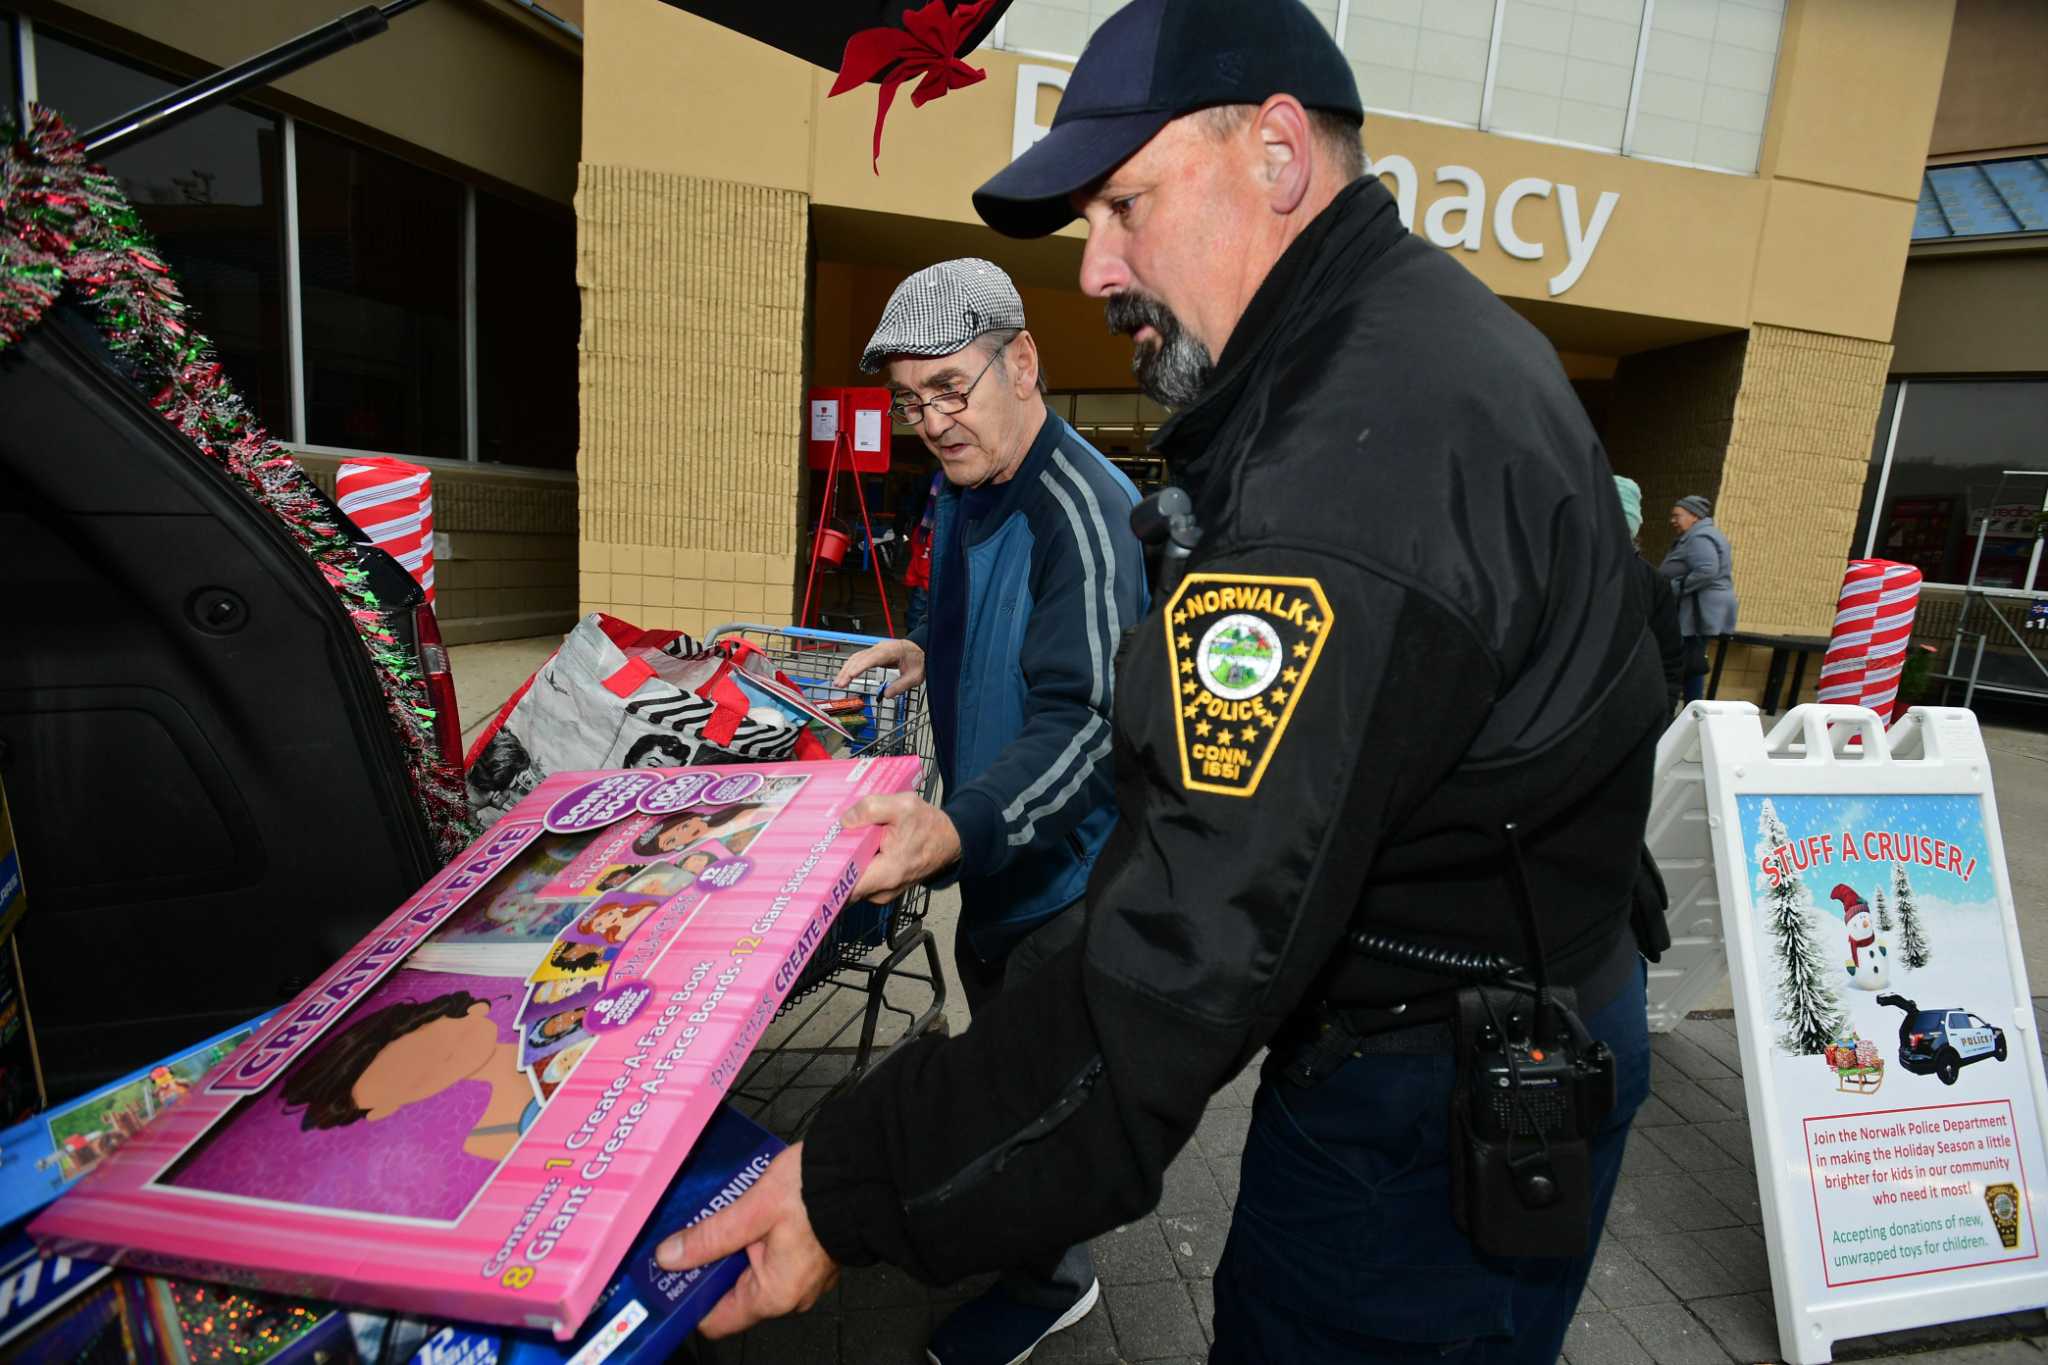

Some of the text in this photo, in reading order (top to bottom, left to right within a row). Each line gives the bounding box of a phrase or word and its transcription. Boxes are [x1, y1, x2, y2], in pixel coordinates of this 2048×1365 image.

[1186, 586, 1311, 626] NORWALK
[1194, 690, 1267, 721] POLICE
[1192, 744, 1251, 766] CONN.
[556, 776, 625, 826] BONUS
[649, 776, 694, 809] 1000
[1762, 832, 1976, 886] STUFF A CRUISER!
[775, 919, 821, 993] CREATE
[833, 861, 858, 905] FACE
[237, 935, 408, 1079] CREATE
[410, 902, 449, 923] A
[445, 826, 531, 890] FACE
[594, 998, 613, 1012] 8
[501, 1265, 536, 1289] 8
[525, 1184, 592, 1262] Giant
[582, 1028, 693, 1181] Create-A-Face
[690, 967, 741, 1023] Boards
[730, 936, 762, 957] 12
[752, 896, 791, 934] Giant
[781, 853, 820, 894] Sticker
[481, 960, 713, 1278] Contains: 1 Create-A-Face Book
[1814, 1114, 2007, 1145] Join the Norwalk Police Department
[1816, 1135, 2012, 1167] in making the Holiday Season a little
[1824, 1156, 2010, 1190] brighter for kids in our community
[687, 1152, 772, 1229] ARNING:
[1872, 1191, 1897, 1206] who
[1900, 1185, 1928, 1202] need
[1929, 1185, 1938, 1199] it
[1940, 1181, 1972, 1198] most!
[1832, 1214, 1984, 1244] Accepting donations of new,
[1834, 1234, 1989, 1268] unwrapped toys for children.
[666, 1278, 687, 1301] Not
